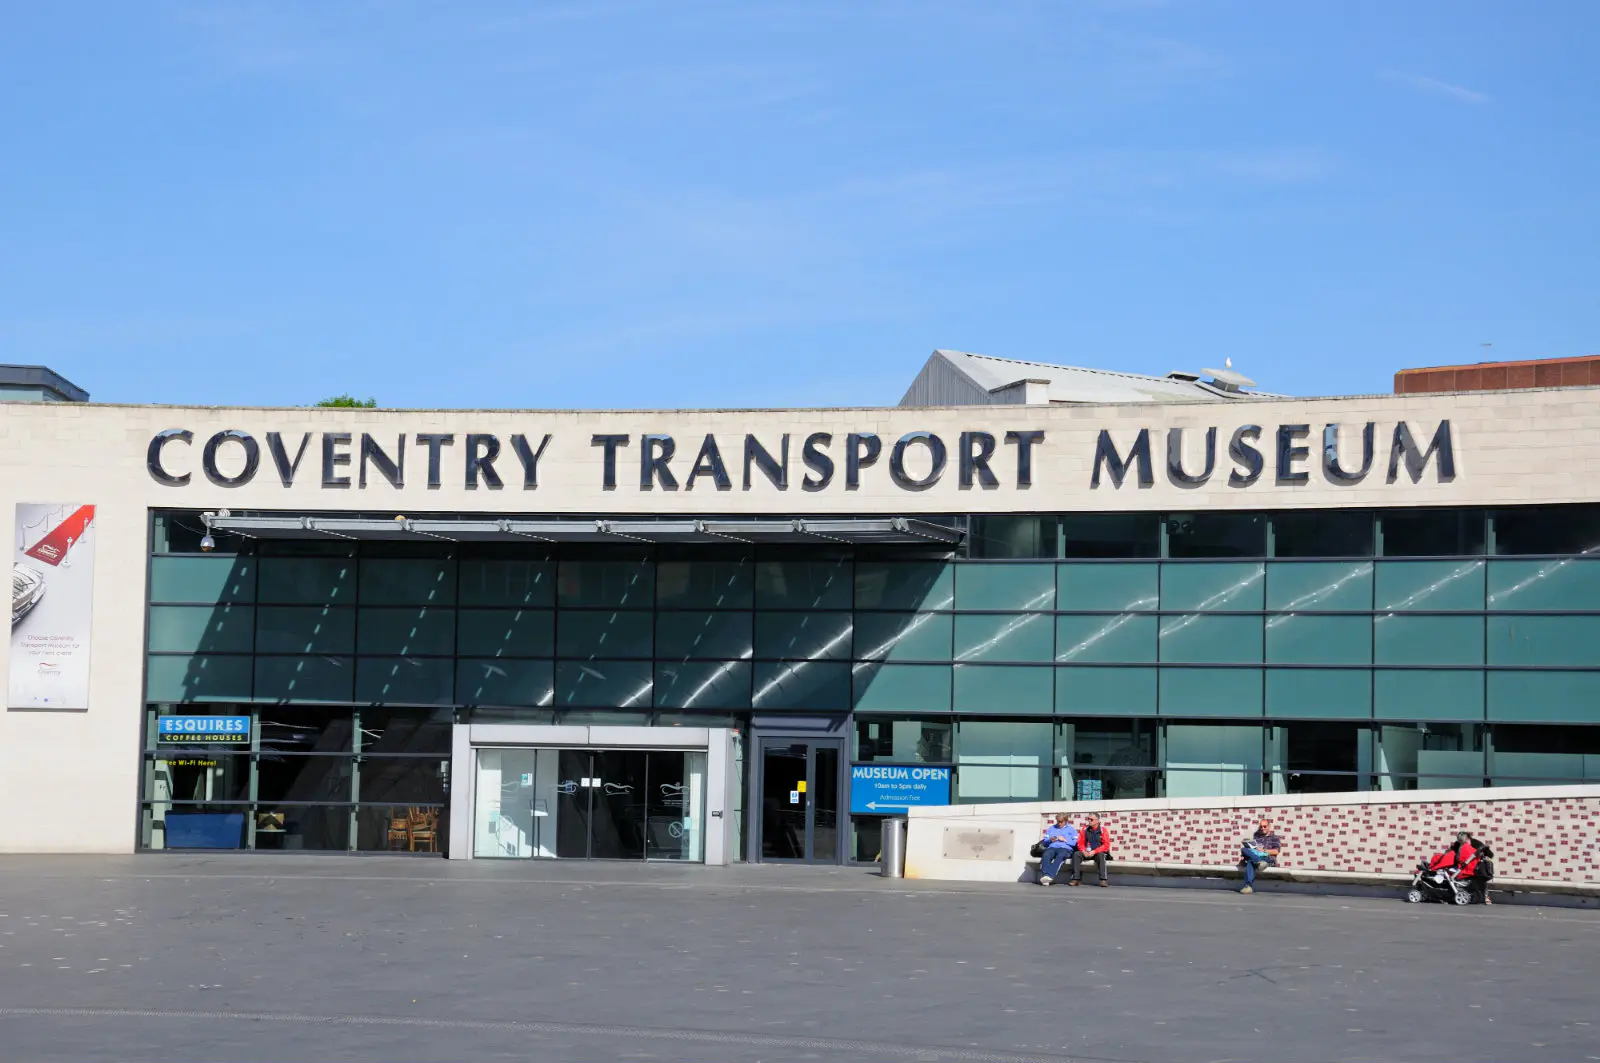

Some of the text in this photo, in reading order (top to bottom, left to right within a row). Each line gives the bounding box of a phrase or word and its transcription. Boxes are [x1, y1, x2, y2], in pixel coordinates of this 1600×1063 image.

[147, 419, 1456, 491] COVENTRY TRANSPORT MUSEUM
[166, 719, 243, 731] ESQUIRES
[853, 767, 948, 780] MUSEUM OPEN
